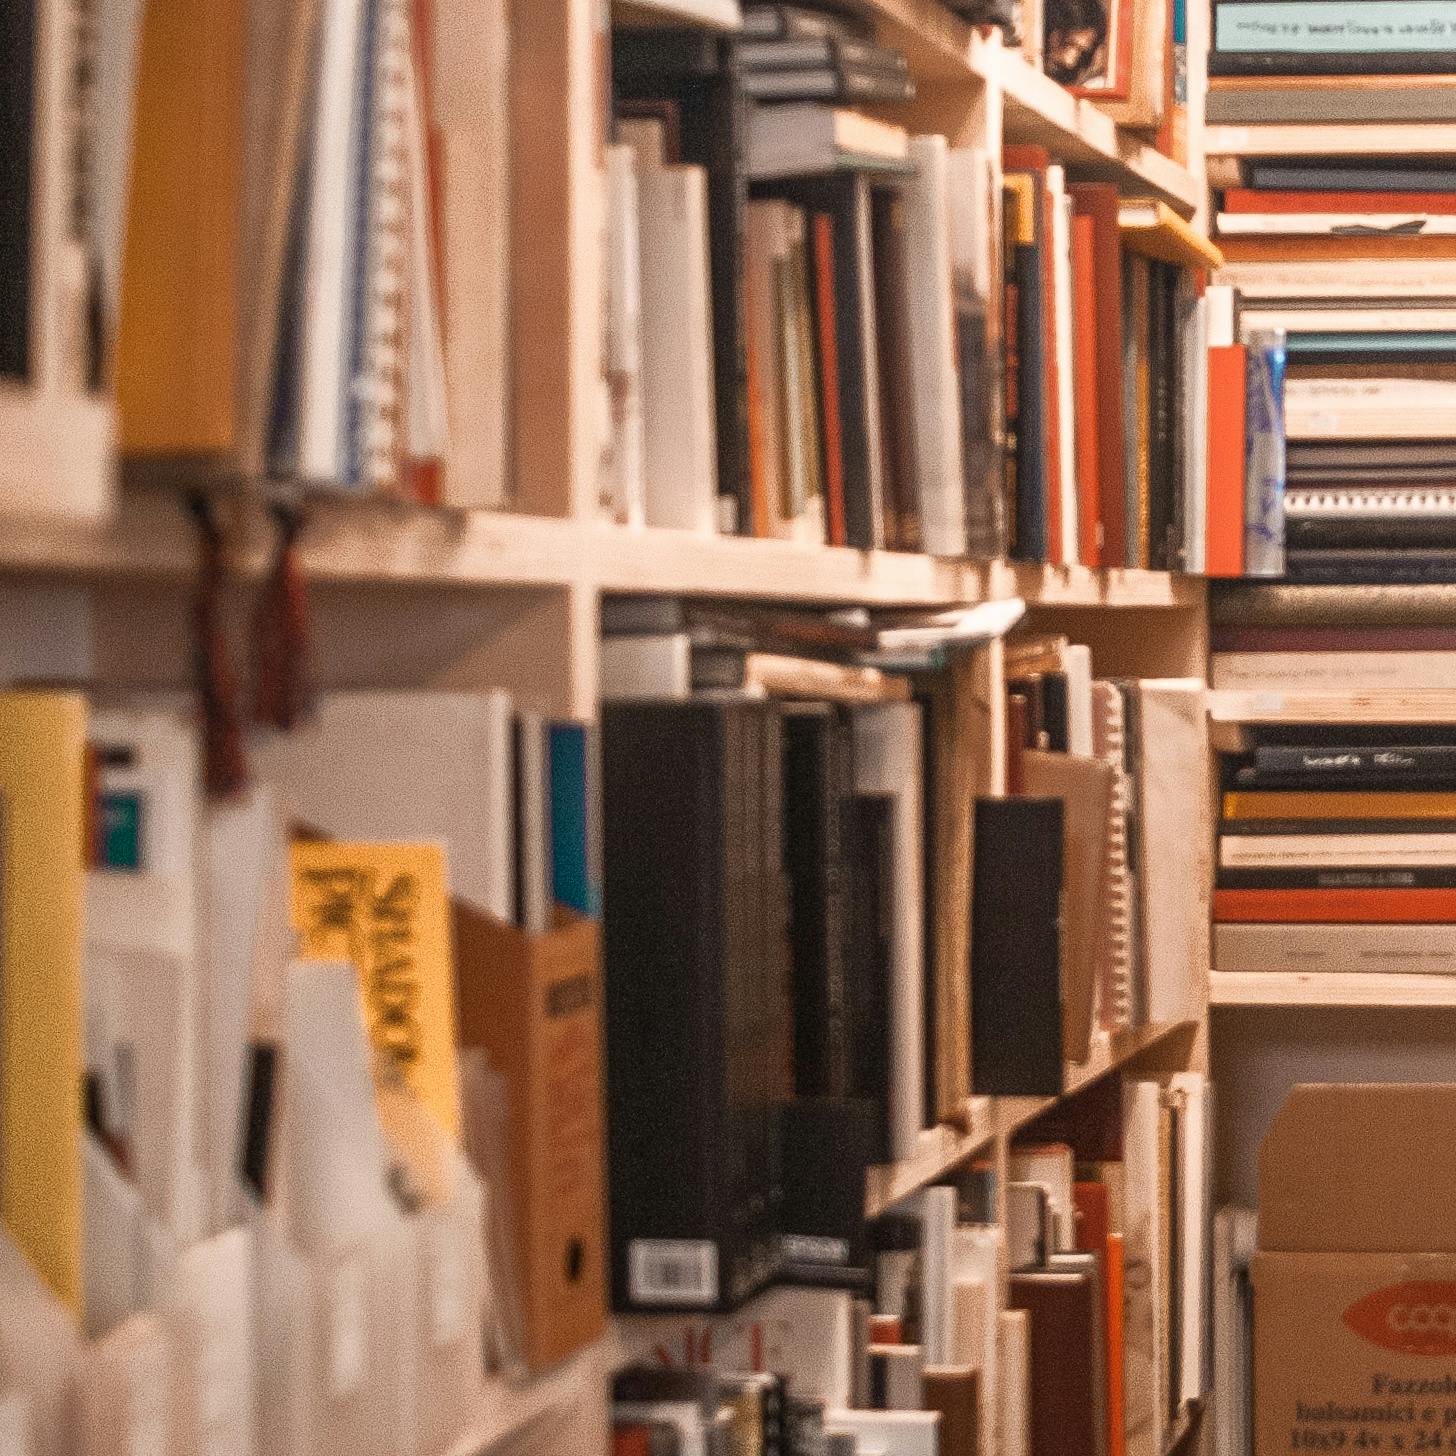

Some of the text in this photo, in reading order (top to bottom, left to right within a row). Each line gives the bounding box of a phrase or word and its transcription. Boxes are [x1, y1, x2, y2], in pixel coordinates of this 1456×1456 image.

[1296, 1400, 1415, 1423] balsamici
[1421, 1406, 1436, 1422] e
[1291, 1428, 1348, 1449] 10x9
[1354, 1428, 1382, 1449] 4v
[1391, 1432, 1405, 1449] x
[1414, 1428, 1442, 1449] 24
